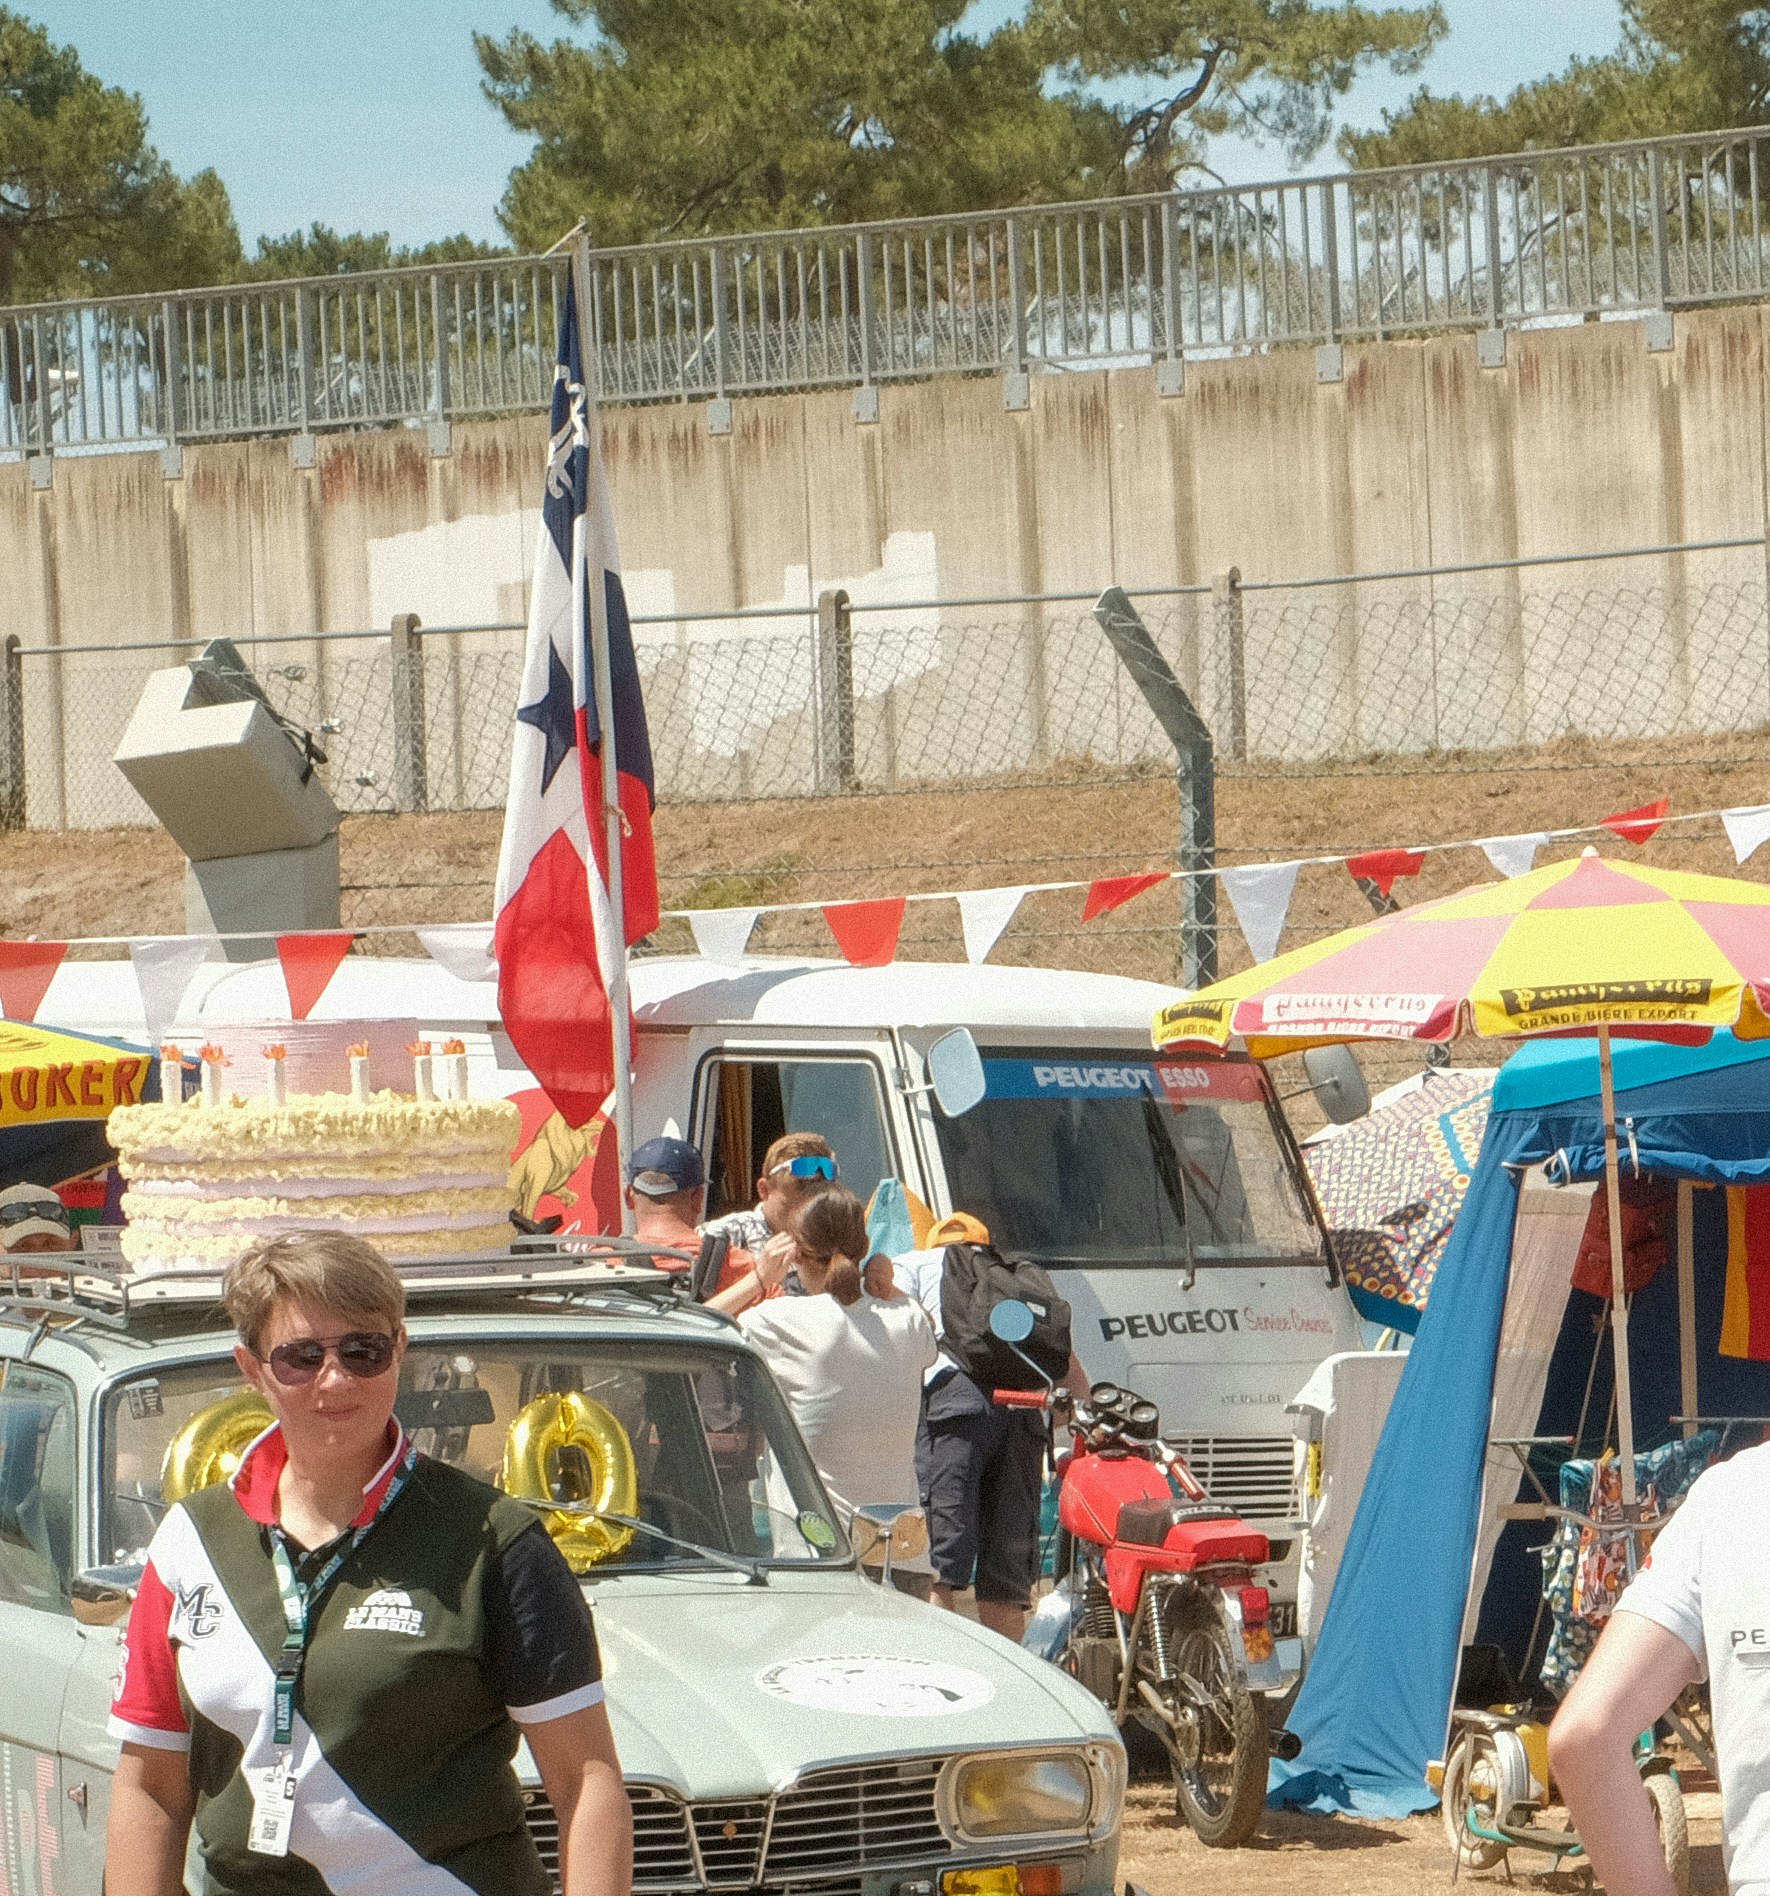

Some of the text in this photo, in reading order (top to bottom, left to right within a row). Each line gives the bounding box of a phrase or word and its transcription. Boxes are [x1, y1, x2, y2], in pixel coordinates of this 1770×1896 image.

[0, 1056, 142, 1113] OKER
[1033, 1066, 1211, 1089] PEUGEOT ESSO
[1099, 1308, 1240, 1342] PEUGEOT
[343, 1615, 420, 1635] CLASSIC
[368, 1606, 424, 1621] MANS
